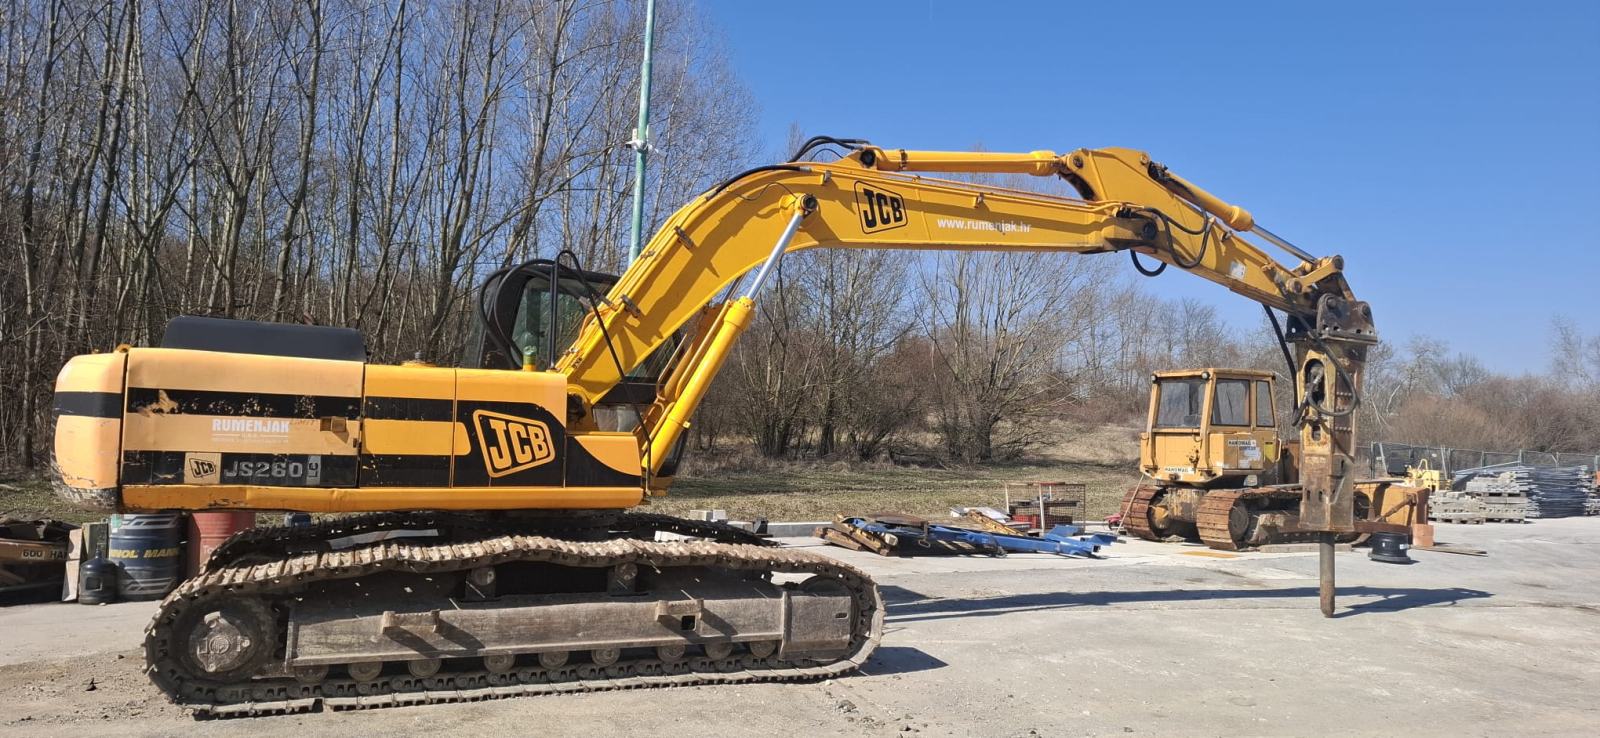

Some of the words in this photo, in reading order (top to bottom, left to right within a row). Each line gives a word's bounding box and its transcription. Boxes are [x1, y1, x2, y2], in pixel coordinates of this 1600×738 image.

[863, 188, 903, 228] JCB
[937, 217, 1032, 233] www.rumenjak.hr
[212, 418, 290, 433] RUMENJAK
[489, 418, 549, 470] JCB
[193, 460, 215, 476] JCB
[223, 460, 303, 478] JS260
